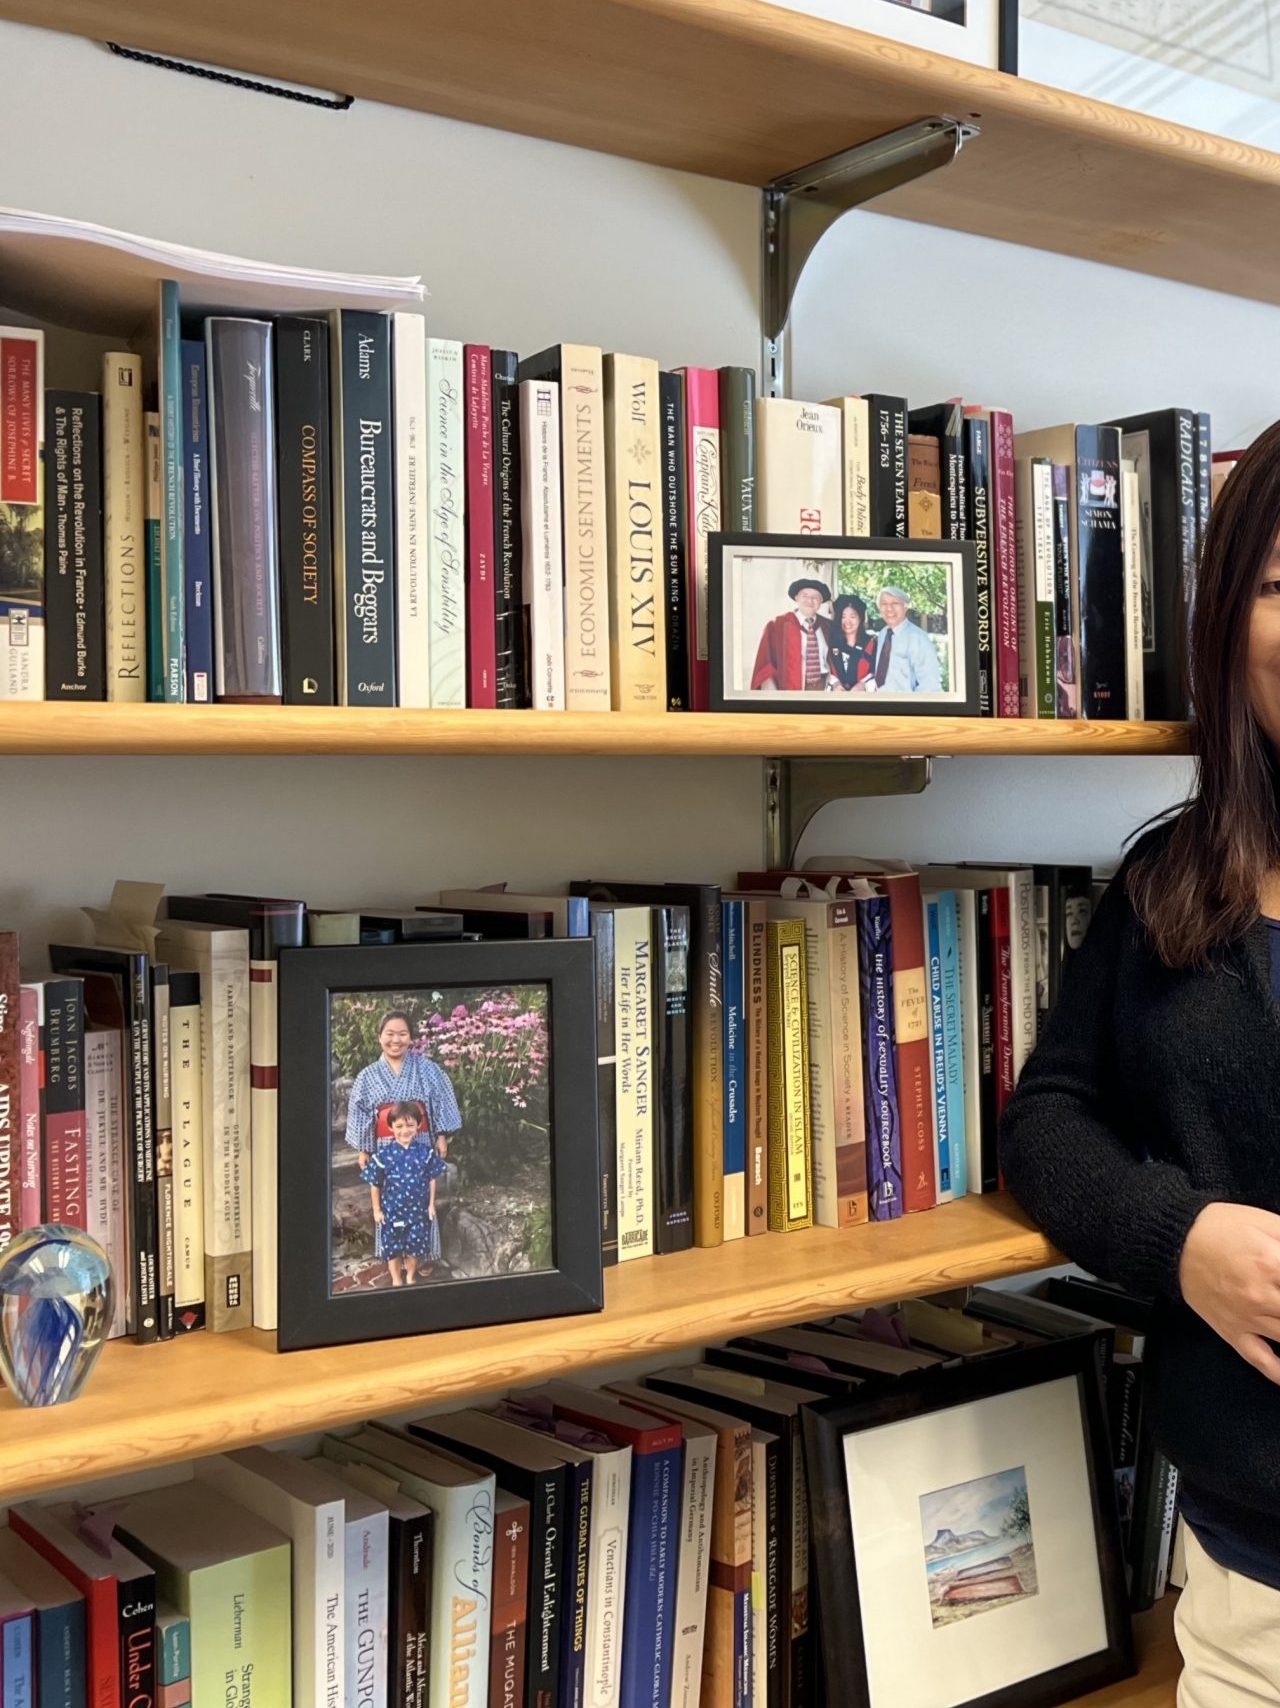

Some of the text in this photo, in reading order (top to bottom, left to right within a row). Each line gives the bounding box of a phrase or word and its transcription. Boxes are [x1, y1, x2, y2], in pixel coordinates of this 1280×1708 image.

[303, 331, 312, 361] CLARK
[358, 333, 373, 379] Adams
[632, 382, 645, 425] Wolf
[796, 421, 823, 434] Orieux
[800, 408, 819, 421] Jean
[895, 411, 905, 436] THE
[667, 425, 675, 446] MAN
[668, 450, 676, 471] WHO
[894, 438, 905, 478] SEVEN
[1179, 417, 1194, 507] RADICALS
[55, 407, 67, 575] & The Rights of Man Thomas Paine
[434, 379, 461, 635] Science in the Age of Sensibility
[500, 400, 512, 599] The Cultural Origins of the French Revolution
[668, 475, 677, 528] OUTSHONE
[895, 480, 905, 516] YEARS
[949, 454, 959, 519] Montesquieu to
[957, 455, 966, 517] French Political
[301, 424, 318, 604] COMPASS OF SOCIETY
[354, 419, 384, 644] Bureaucrats and Beggars
[576, 405, 596, 657] ECONOMIC SENTIMENTS
[670, 532, 678, 550] THE
[1081, 519, 1116, 530] SCHAMA
[1084, 510, 1112, 519] SIMON
[71, 408, 87, 676] Reflections on the Revolution in France Edmund Burke
[629, 479, 655, 657] LOUIS XIV
[670, 555, 678, 574] SUN
[975, 486, 989, 651] SUBVERSIVE WORDS
[118, 535, 140, 679] REFLECTIONS
[671, 579, 679, 602] KING
[8, 648, 17, 695] GULLAND
[20, 652, 29, 691] SANDRA
[61, 683, 87, 691] Anchor
[170, 658, 178, 696] PEARSON
[358, 682, 384, 692] Oxford
[728, 928, 736, 961] Mitchell
[753, 922, 764, 1004] BLINDNESS
[634, 940, 650, 1118] MARGARET SANGER
[901, 996, 925, 1007] FEVER
[944, 967, 958, 1086] THE SECRET MALADY
[49, 1008, 62, 1083] BRUMBERG
[64, 997, 79, 1091] JOAN JACOBS
[620, 966, 632, 1094] Her Life in Her Words
[789, 953, 804, 1155] SCIENCE & CIVILIZATION IN ISLAM
[931, 957, 947, 1142] CHILD ABUSE IN FREUD'S VIENNA
[728, 1005, 738, 1124] Medicine in the Crusades
[181, 1020, 192, 1209] THE PLAGUE
[914, 1066, 925, 1151] STEPHEN COSS
[23, 1113, 36, 1188] Notes on Nursing
[64, 1128, 81, 1217] FASTING
[713, 1192, 721, 1230] OXFORD
[661, 1467, 670, 1523] COMPANION
[685, 1458, 699, 1544] in Imperial Germany
[660, 1526, 667, 1538] TO
[695, 1456, 710, 1593] Anthropology and Antihumanism
[412, 1532, 423, 1574] Thornton
[573, 1479, 589, 1652] THE GLOBAL LIVES OF THINGS
[659, 1541, 667, 1569] EARLY
[122, 1602, 154, 1618] Cohen
[358, 1589, 369, 1625] THE
[597, 1540, 617, 1696] Venetians in Constantinople
[656, 1572, 665, 1612] MODERN
[232, 1594, 245, 1649] Lieberman
[326, 1594, 339, 1684] The American
[505, 1619, 516, 1650] THE
[654, 1614, 663, 1662] CATHOLIC
[128, 1628, 152, 1689] Under
[226, 1671, 237, 1684] in
[405, 1633, 416, 1692] of the Atlantic
[653, 1664, 661, 1699] GLOBAL
